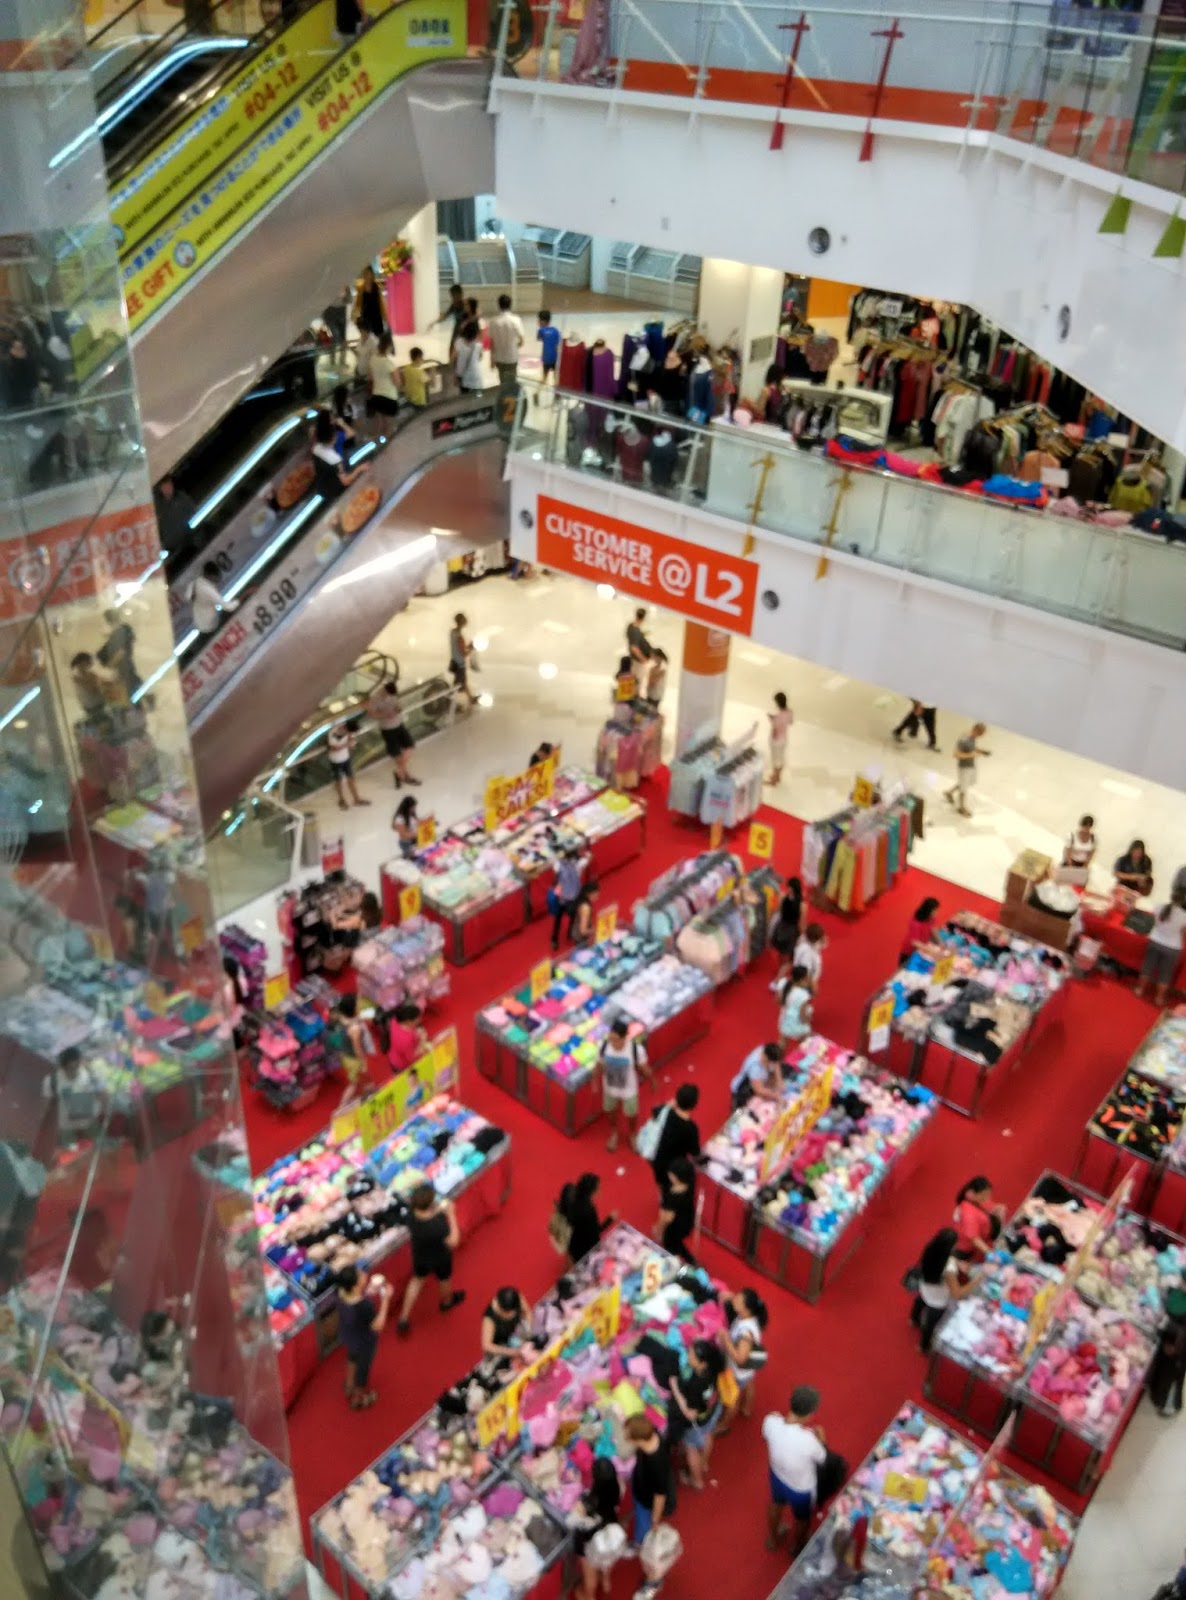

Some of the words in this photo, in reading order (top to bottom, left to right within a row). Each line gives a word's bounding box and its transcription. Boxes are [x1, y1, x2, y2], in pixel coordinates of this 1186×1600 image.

[245, 62, 298, 119] #04-12
[305, 77, 333, 108] VISIT
[330, 62, 350, 83] US
[317, 70, 373, 131] #04-12
[142, 261, 175, 298] GIFT
[503, 396, 516, 425] 2
[544, 513, 653, 565] CUSTOMER
[572, 542, 652, 586] SERVICE
[199, 620, 248, 676] LUNCH
